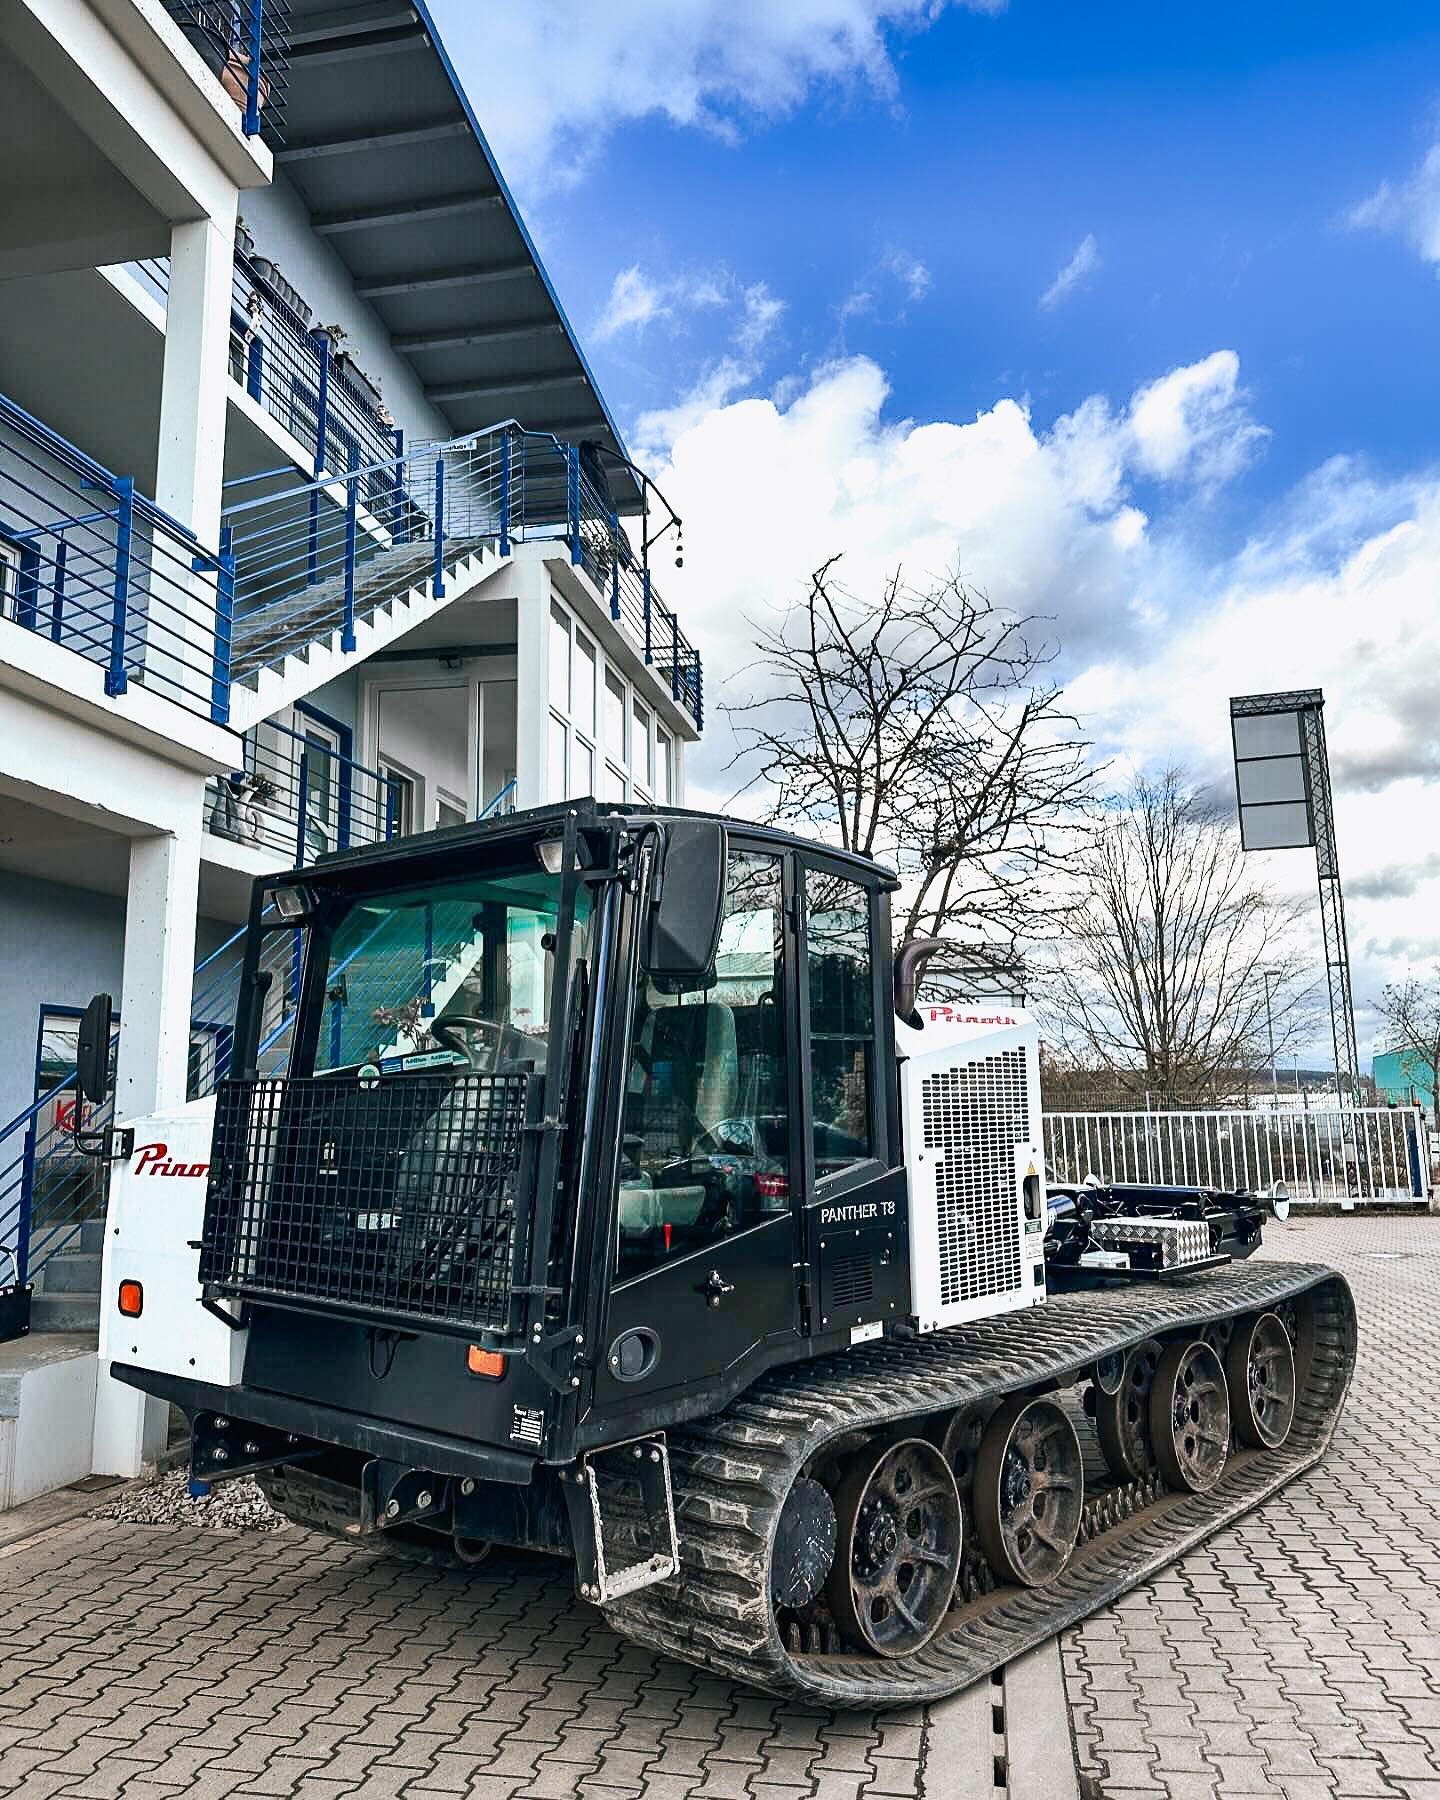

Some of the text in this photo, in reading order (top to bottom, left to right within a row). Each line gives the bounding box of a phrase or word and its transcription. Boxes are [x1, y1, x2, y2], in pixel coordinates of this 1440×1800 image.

[134, 1142, 210, 1177] Prino
[821, 1200, 896, 1224] PANTHER T8
